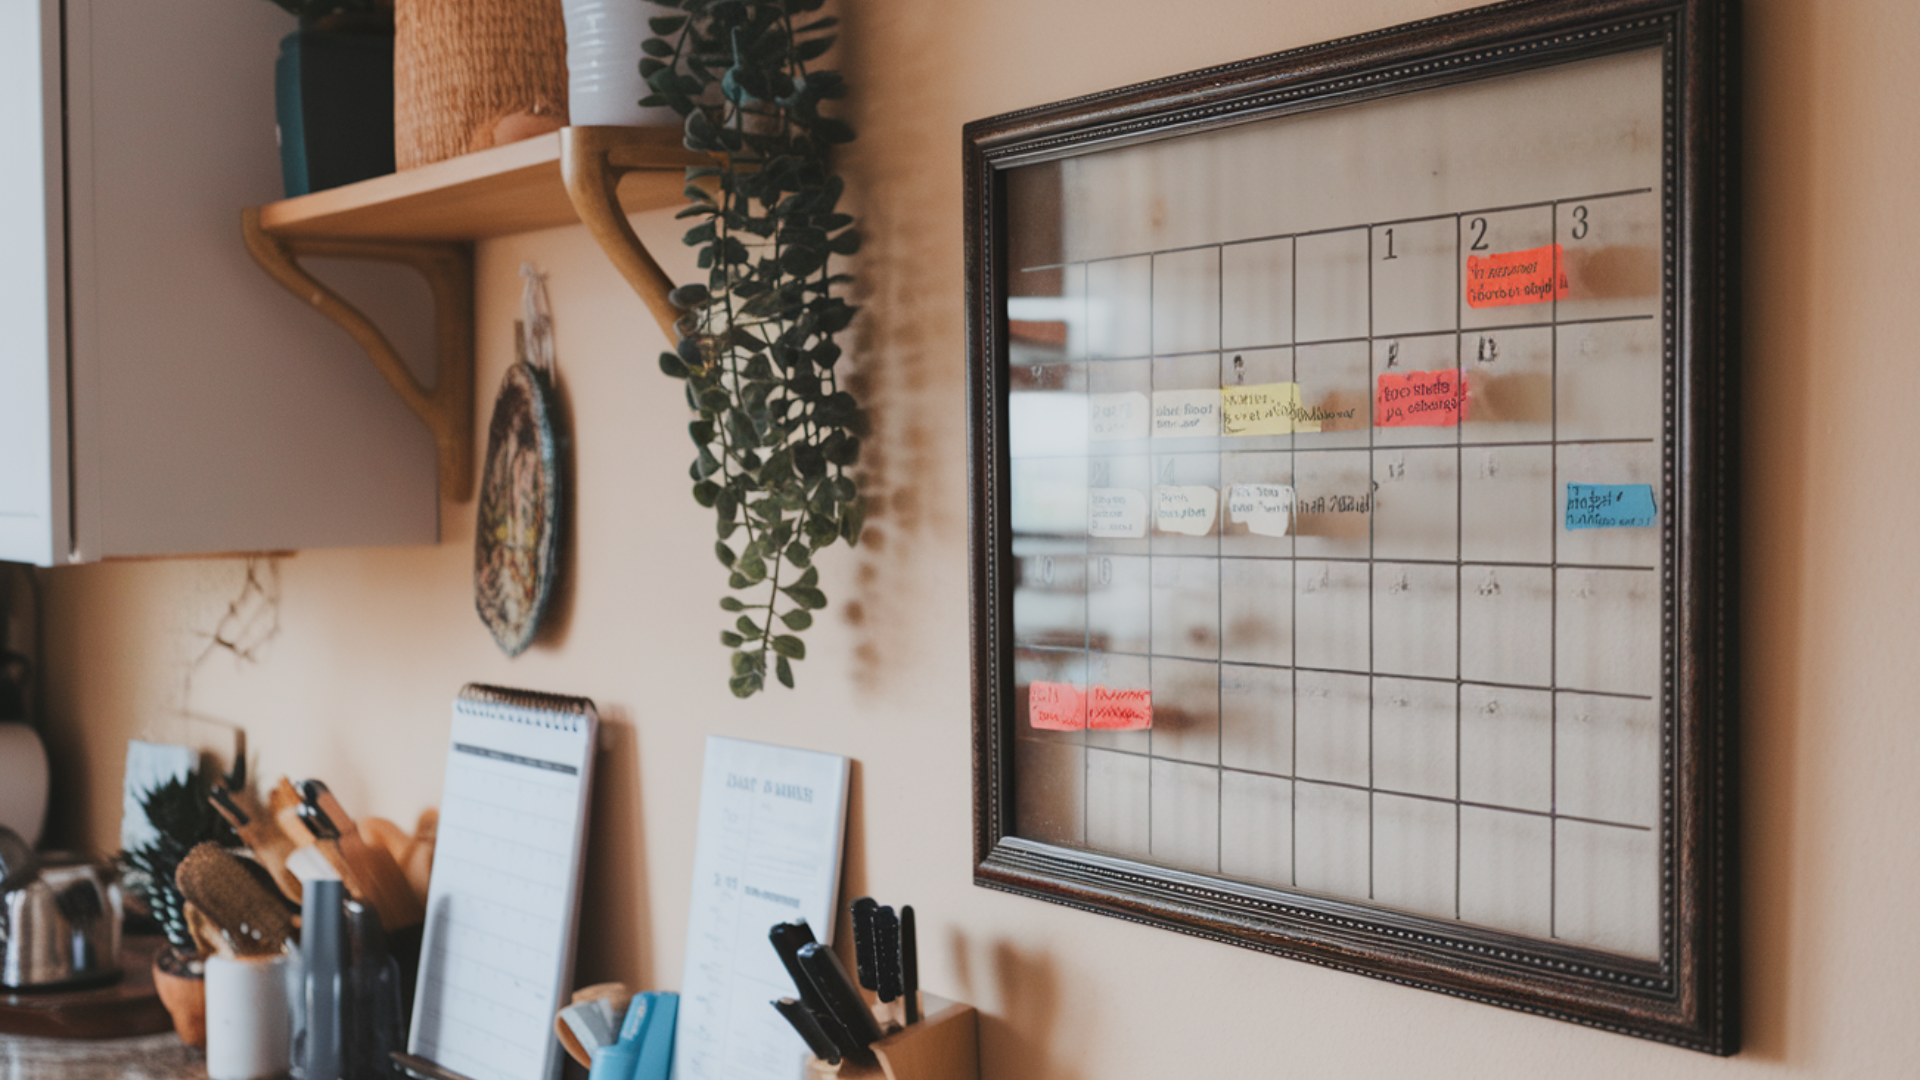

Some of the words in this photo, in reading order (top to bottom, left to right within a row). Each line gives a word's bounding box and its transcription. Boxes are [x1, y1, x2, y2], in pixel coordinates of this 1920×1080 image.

[1382, 228, 1398, 260] 1
[1470, 217, 1489, 251] 2
[1571, 205, 1589, 240] 3
